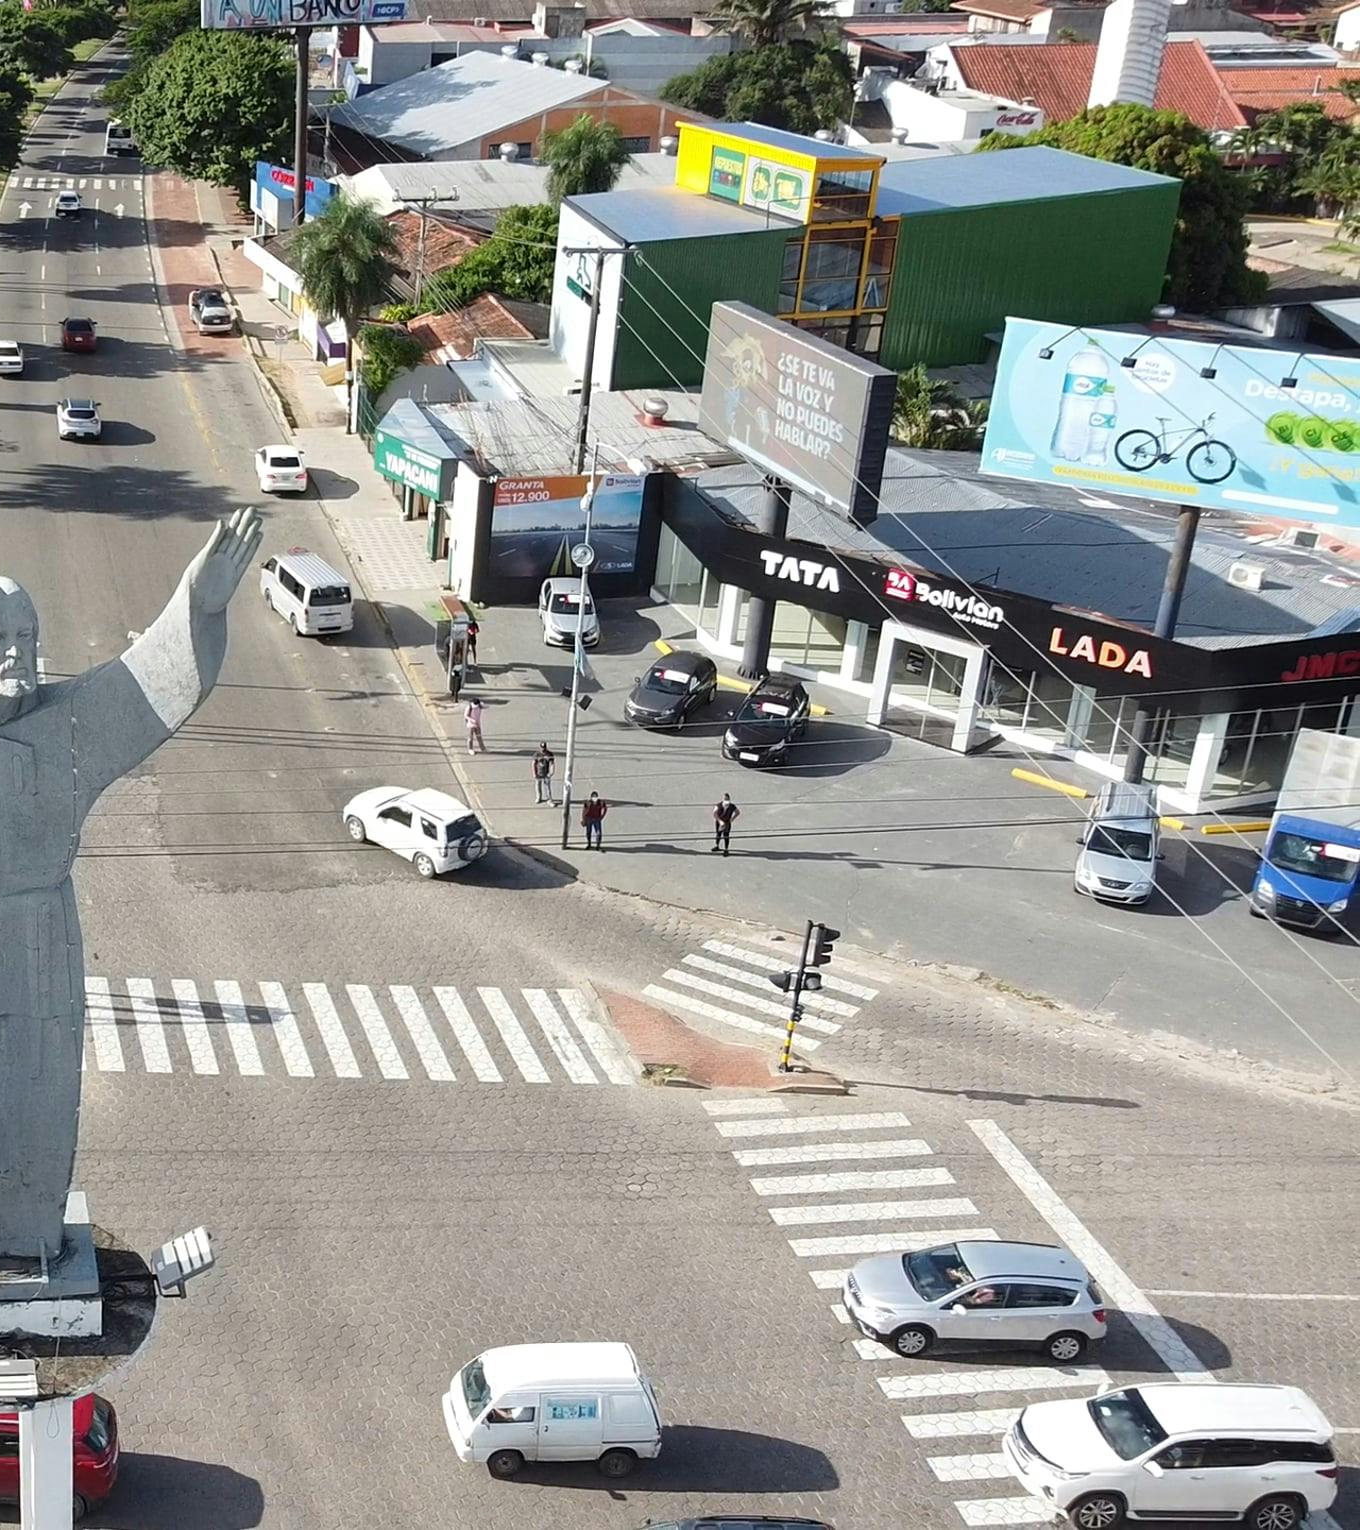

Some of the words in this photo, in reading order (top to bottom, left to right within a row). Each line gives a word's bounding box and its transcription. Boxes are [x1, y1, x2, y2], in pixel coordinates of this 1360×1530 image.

[777, 352, 800, 376] ¿SE
[802, 361, 817, 383] TE
[818, 366, 835, 391] VA
[778, 374, 793, 397] LA
[796, 381, 822, 409] VOZ
[823, 393, 835, 413] Y
[775, 419, 831, 460] HABLAR?
[777, 398, 795, 420] NO
[797, 406, 844, 443] PUEDES
[499, 480, 544, 490] GRANTA
[512, 490, 550, 503] 12.900
[760, 550, 840, 593] TATA
[915, 582, 1004, 623] Bolivian
[1048, 627, 1152, 678] LADA
[1280, 650, 1360, 682] JMC
